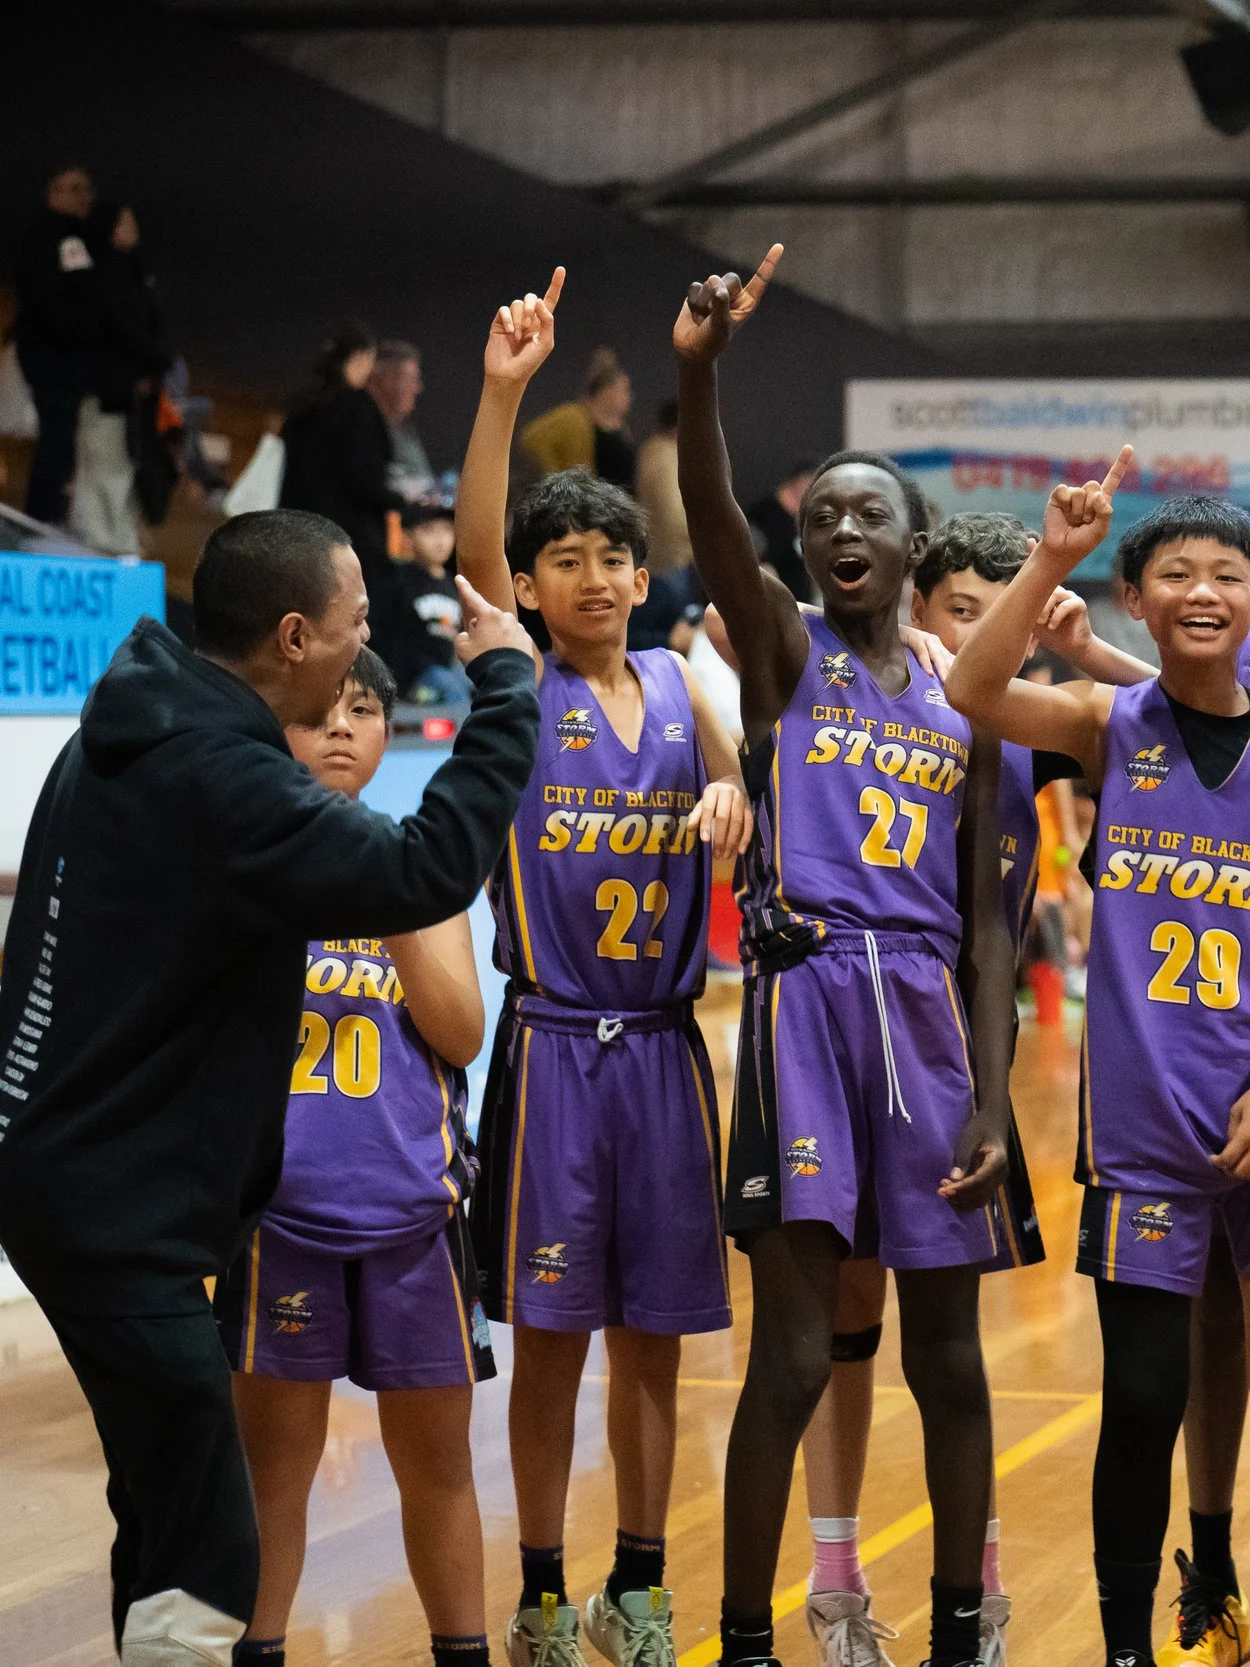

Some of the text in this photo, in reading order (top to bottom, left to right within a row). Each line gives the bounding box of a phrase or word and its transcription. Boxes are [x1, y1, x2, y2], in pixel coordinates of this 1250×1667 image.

[36, 566, 116, 621] COAST
[812, 705, 856, 724] CITY
[860, 718, 878, 735] F
[805, 726, 966, 798] STORM
[543, 785, 587, 806] CITY
[593, 789, 623, 807] OF
[859, 786, 929, 871] 27
[1107, 825, 1154, 847] CITY
[1158, 831, 1185, 851] OF
[595, 878, 669, 961] 22
[306, 955, 409, 1007] ORM
[1147, 921, 1241, 1010] 29
[289, 1011, 381, 1098] 20
